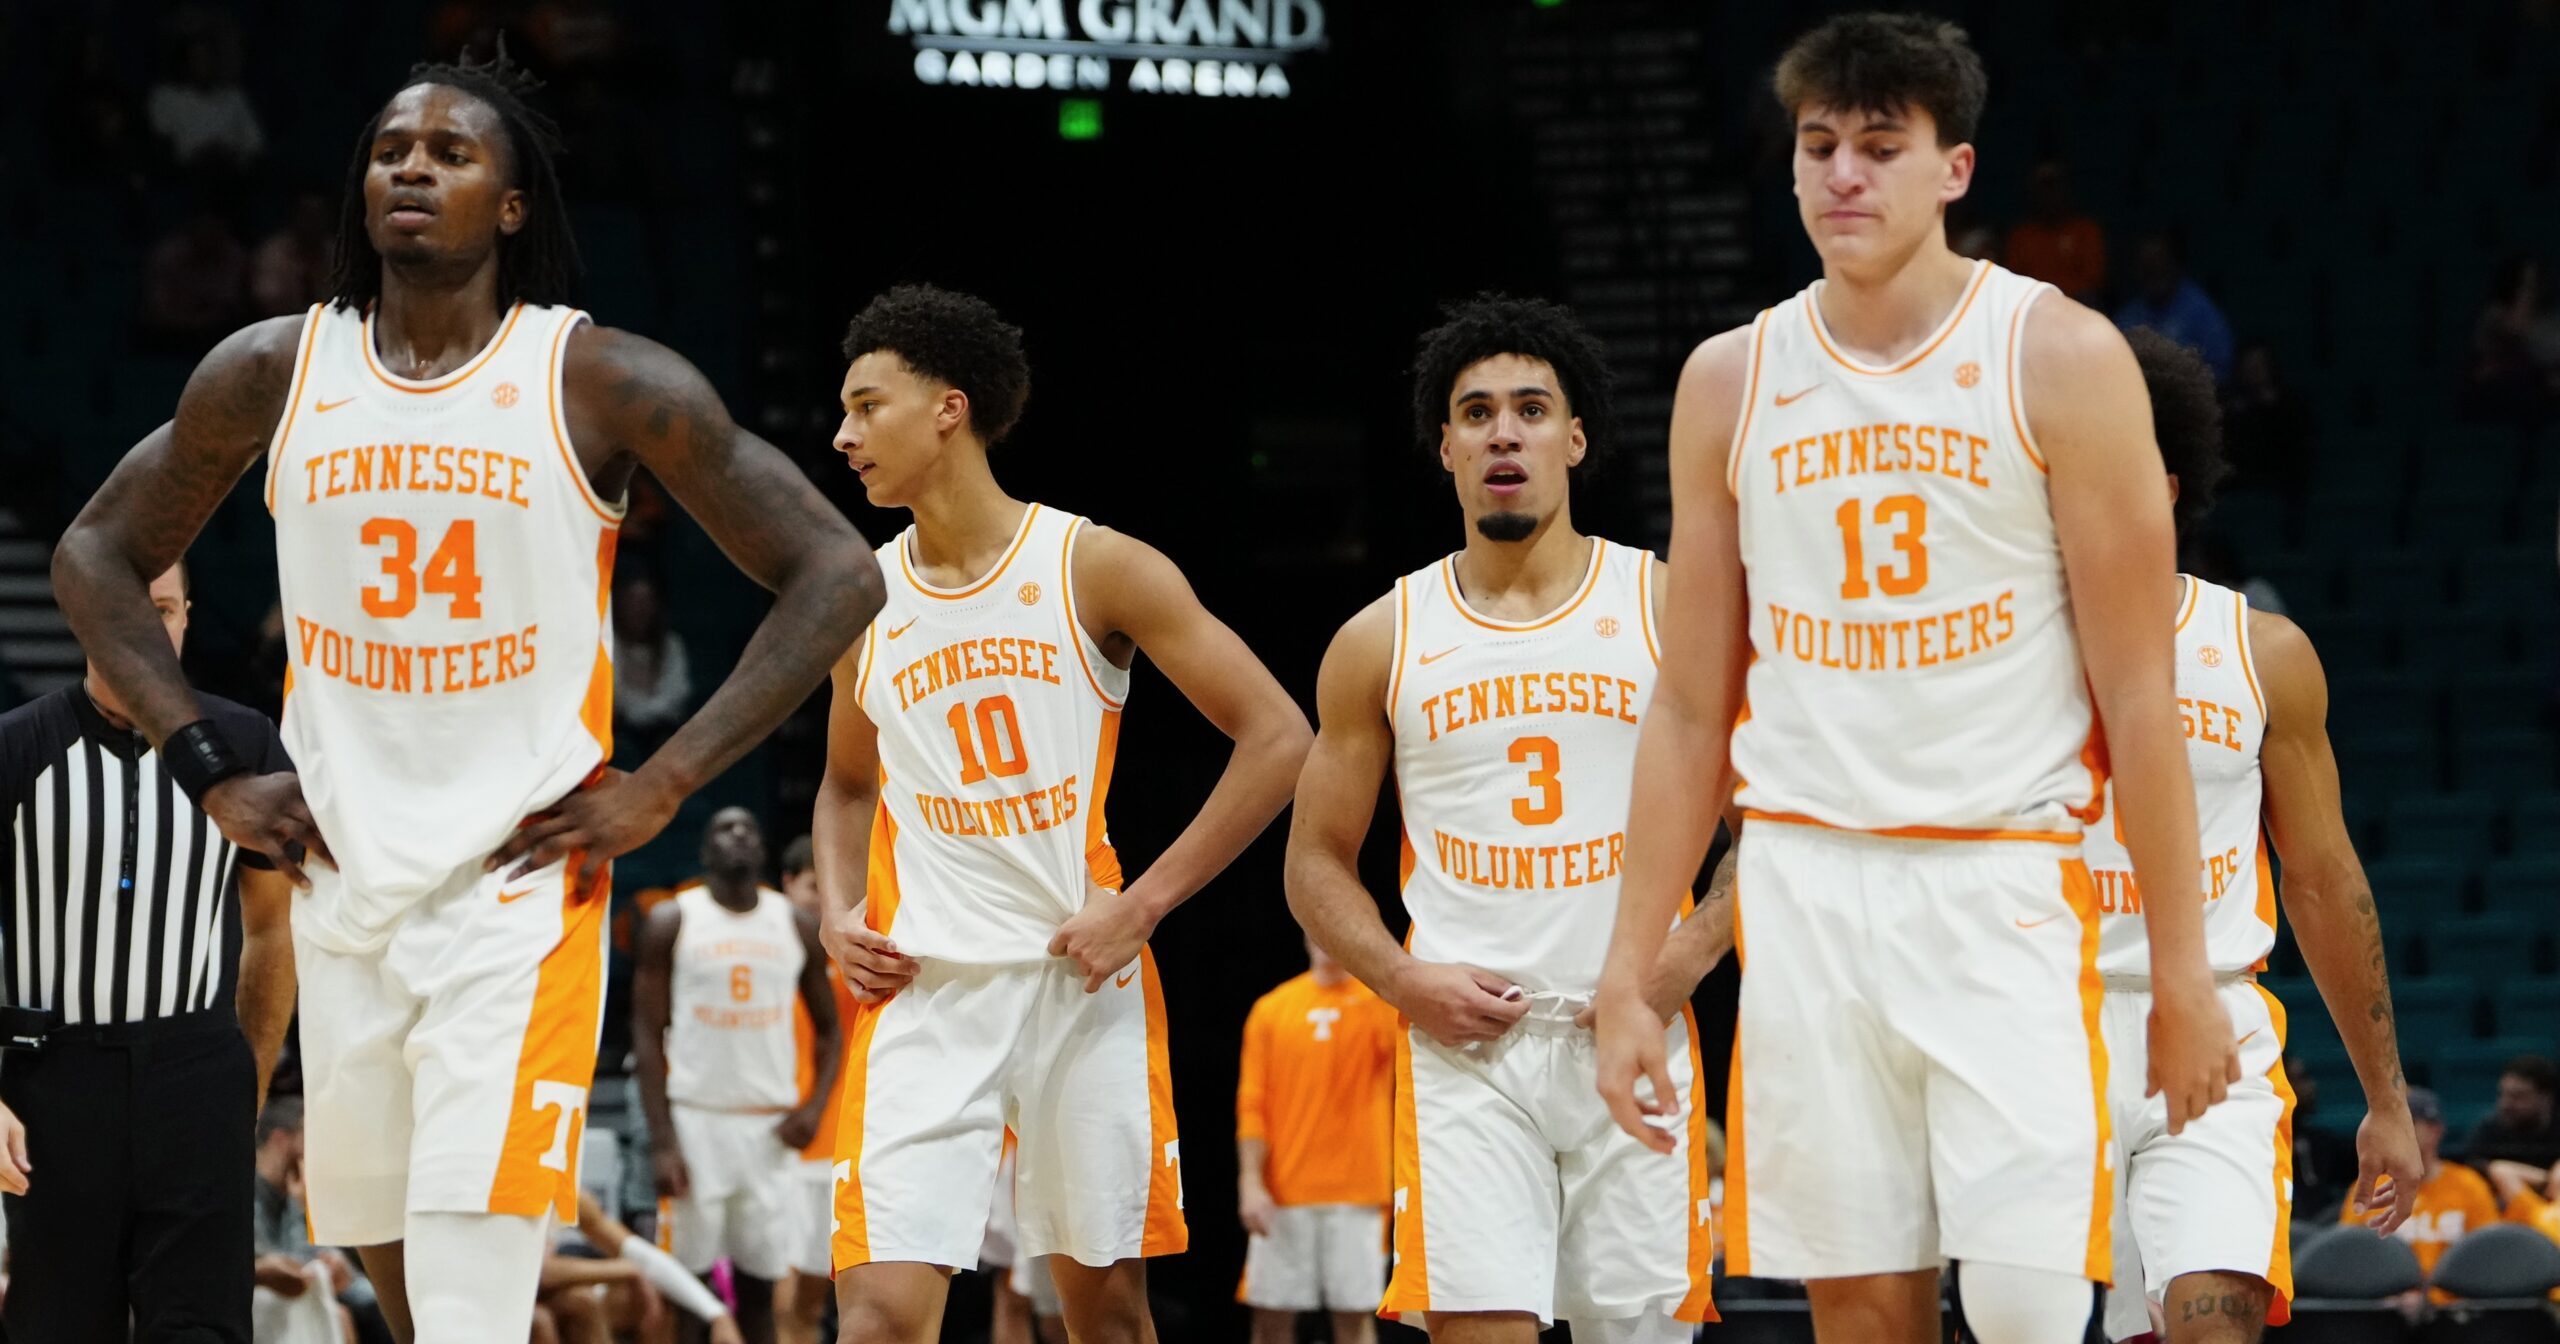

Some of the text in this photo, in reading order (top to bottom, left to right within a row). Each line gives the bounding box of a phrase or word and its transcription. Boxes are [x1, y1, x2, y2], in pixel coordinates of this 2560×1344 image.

[888, 0, 1327, 49] MGM GRAND
[1128, 57, 1291, 98] ARENA
[305, 444, 531, 508] TENNESSEE
[1770, 423, 1990, 494] TENNESSEE
[360, 516, 482, 619] 34
[1836, 494, 1929, 601] 13
[1019, 583, 1040, 604] SEC
[1595, 617, 1619, 637] SEC
[296, 614, 538, 694] VOLUNTEERS
[1768, 589, 2014, 672] VOLUNTEERS
[892, 637, 1061, 712] TENNESSEE
[1421, 672, 1638, 742] TENNESSEE
[946, 694, 1029, 785] 10
[1507, 736, 1563, 826] 3
[1434, 829, 1626, 890] VOLUNTEER
[730, 964, 752, 1002] 6
[1306, 1008, 1341, 1041] T
[531, 1079, 587, 1173] T
